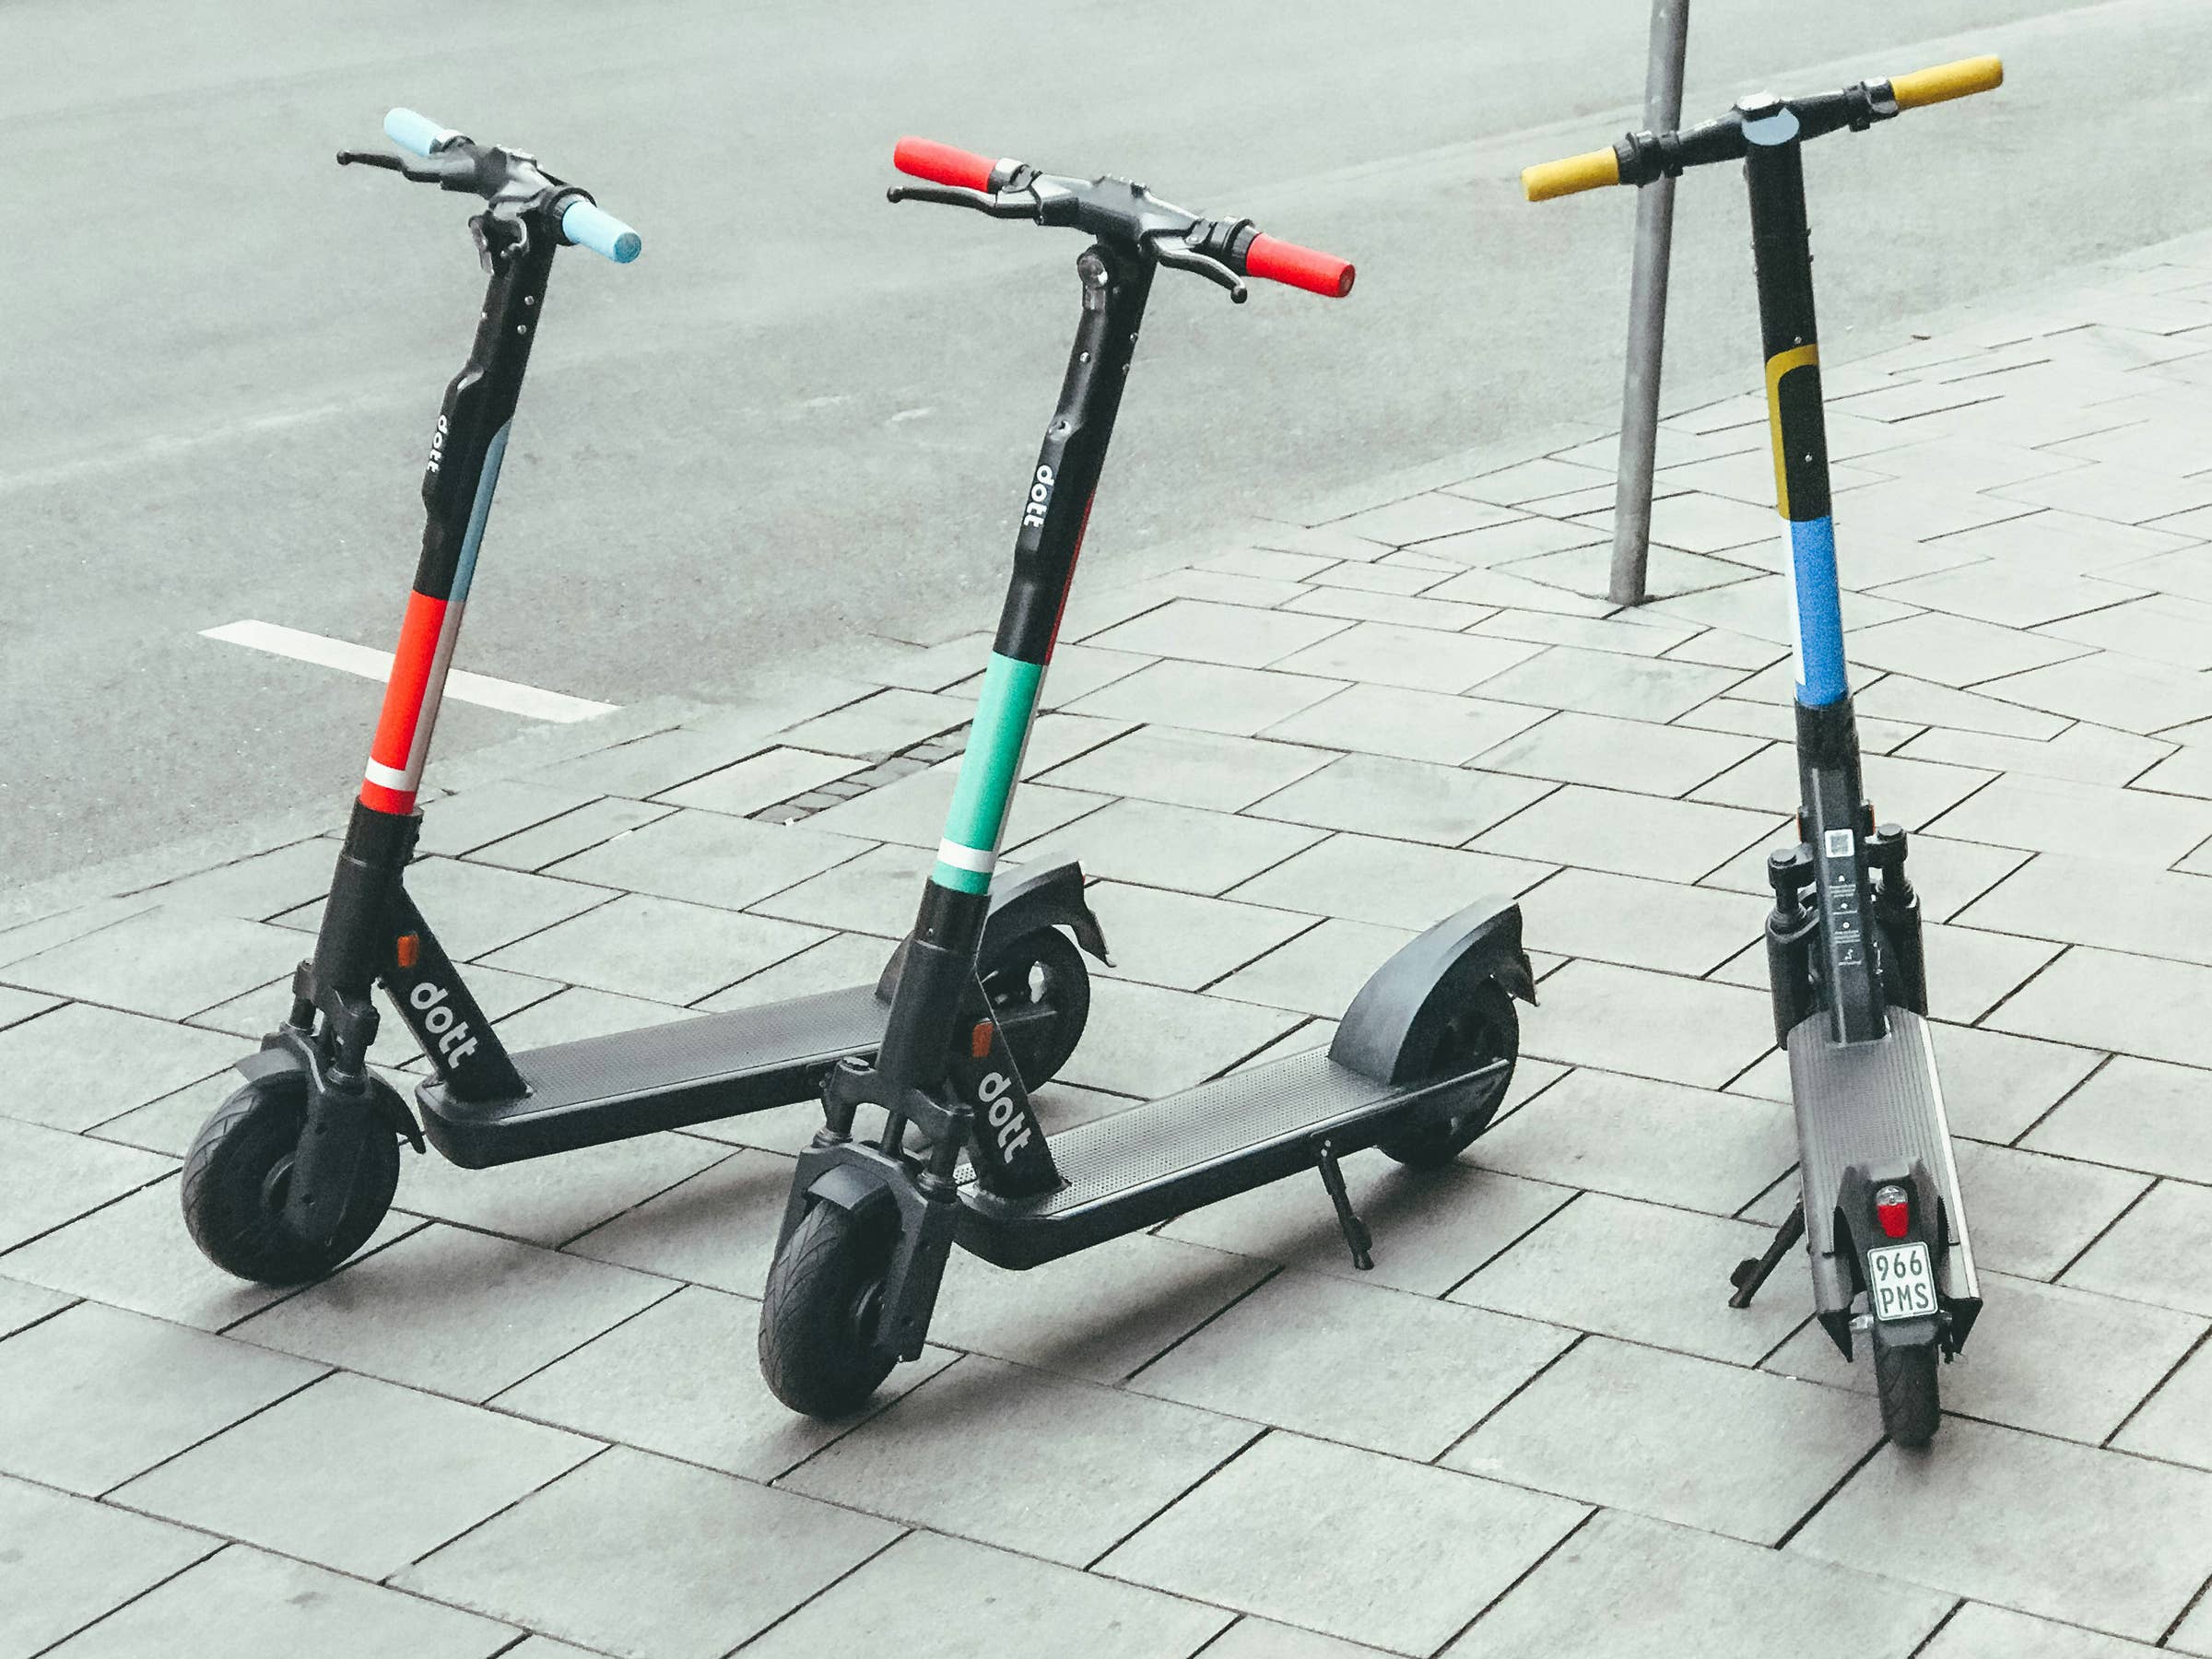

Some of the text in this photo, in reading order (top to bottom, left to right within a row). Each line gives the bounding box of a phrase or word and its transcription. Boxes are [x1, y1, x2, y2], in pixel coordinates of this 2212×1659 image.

[427, 414, 448, 473] dott
[1023, 465, 1054, 527] dott
[410, 982, 478, 1069] dott
[978, 1072, 1031, 1163] dott
[1876, 1250, 1923, 1281] 966
[1879, 1282, 1929, 1313] PMS
